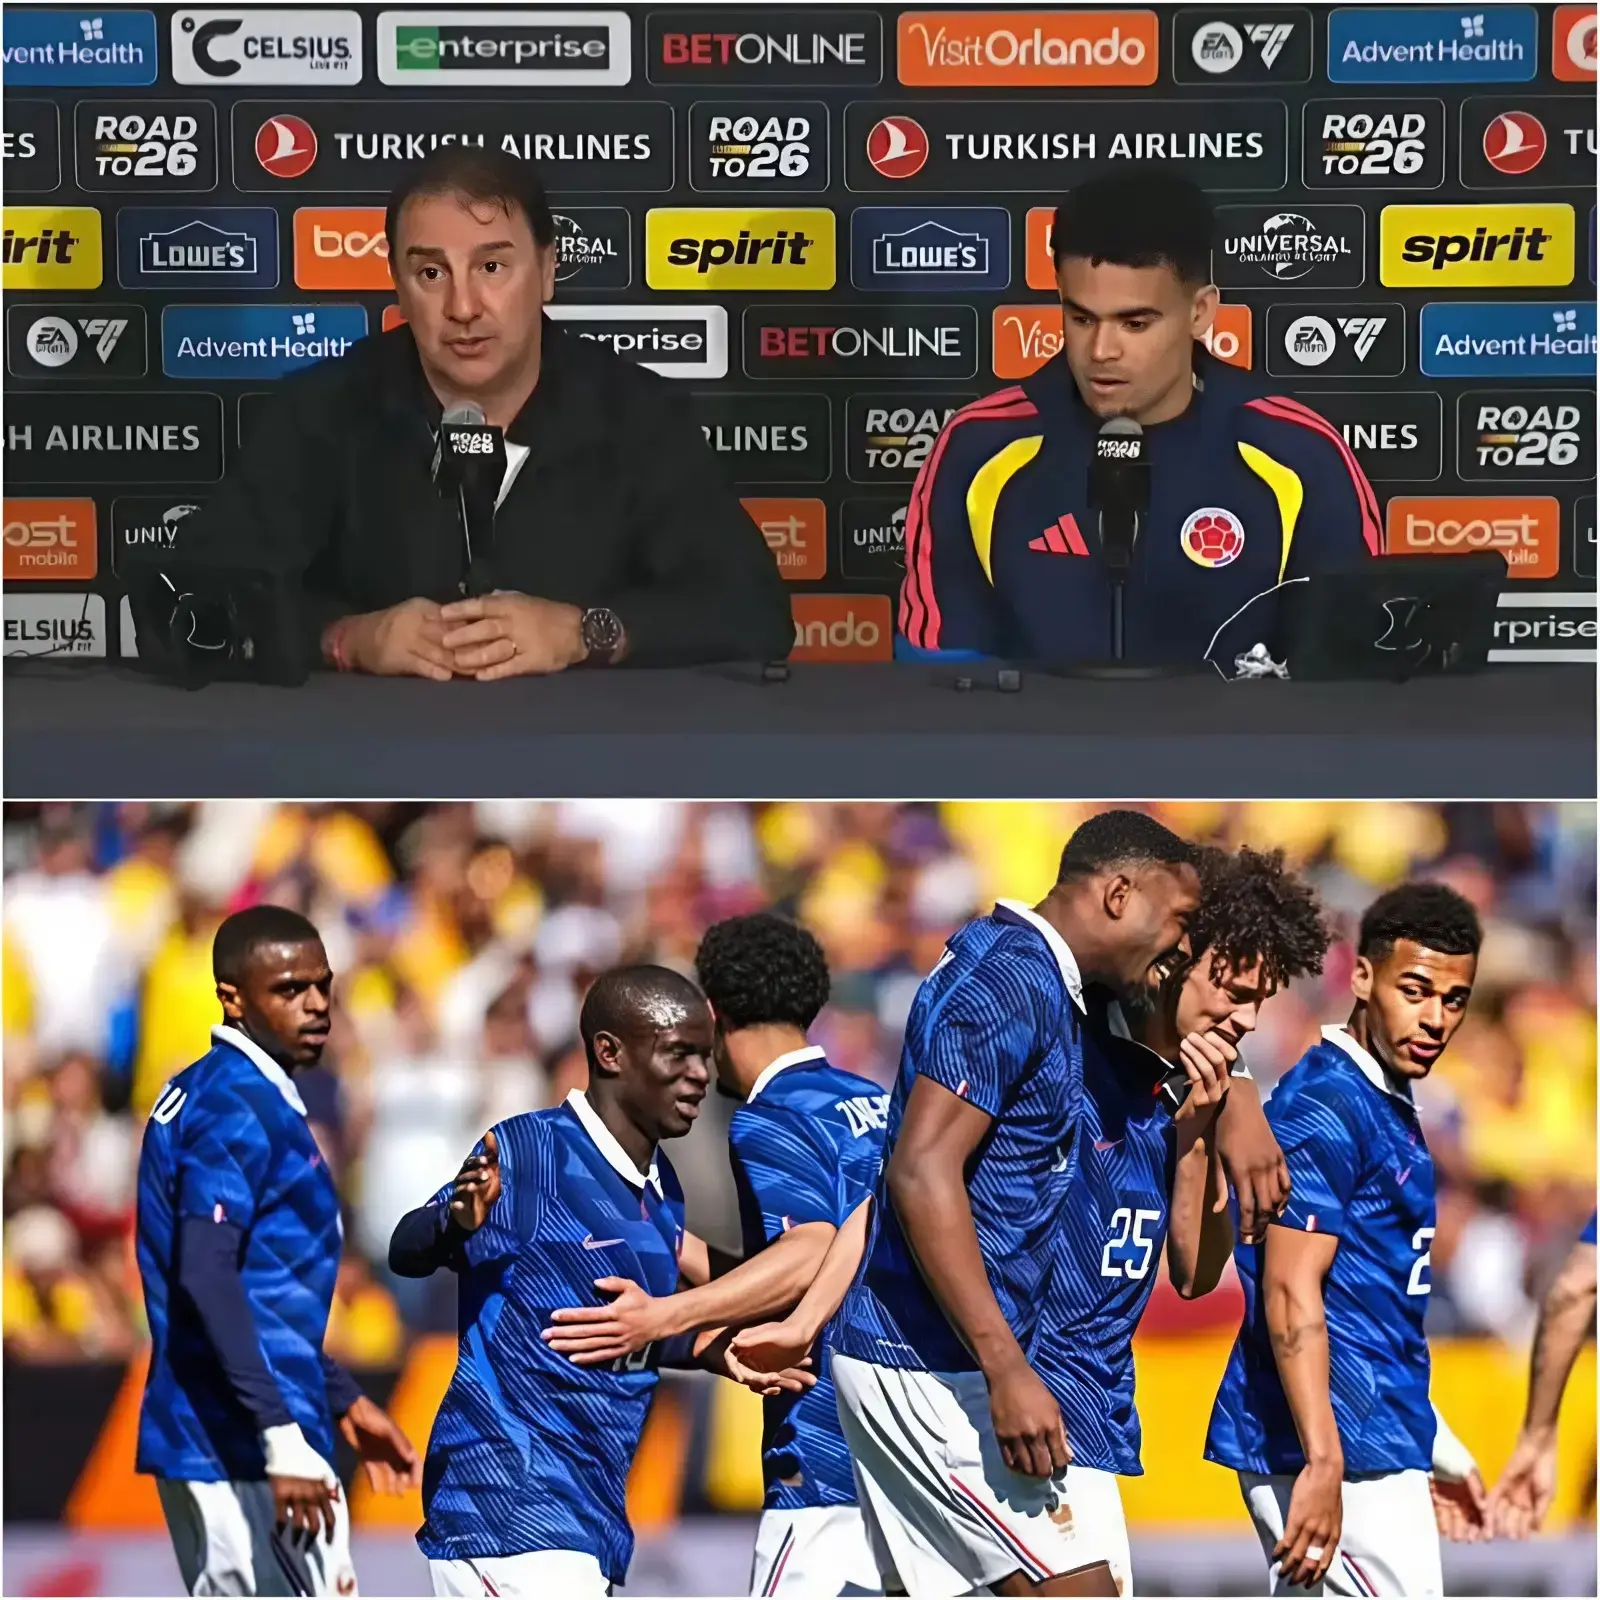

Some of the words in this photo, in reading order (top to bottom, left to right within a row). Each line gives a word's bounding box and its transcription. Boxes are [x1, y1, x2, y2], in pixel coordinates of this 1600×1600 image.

[408, 34, 606, 64] enterprise
[663, 34, 866, 64] BETONLINE
[95, 115, 197, 140] ROAD
[709, 116, 810, 141] ROAD
[1322, 113, 1426, 139] ROAD
[95, 156, 132, 176] TO
[134, 141, 198, 176] 26
[501, 133, 651, 160] AIRLINES
[709, 158, 745, 177] TO
[747, 142, 810, 177] 26
[946, 133, 1096, 160] TURKISH
[1108, 132, 1263, 159] AIRLINES
[1322, 155, 1359, 175] TO
[1361, 140, 1425, 175] 26
[555, 236, 618, 256] RSAL
[667, 231, 812, 273] spirit
[886, 242, 977, 268] LOWE'S
[1224, 234, 1351, 254] UNIVERSAL
[1401, 227, 1549, 270] spirit
[760, 326, 961, 356] BETONLINE
[1476, 405, 1580, 431] ROAD
[45, 425, 200, 451] AIRLINES
[1476, 446, 1513, 466] TO
[1515, 431, 1580, 466] 26
[865, 448, 902, 468] TO
[1406, 514, 1539, 546] boost
[1101, 1207, 1161, 1280] 25
